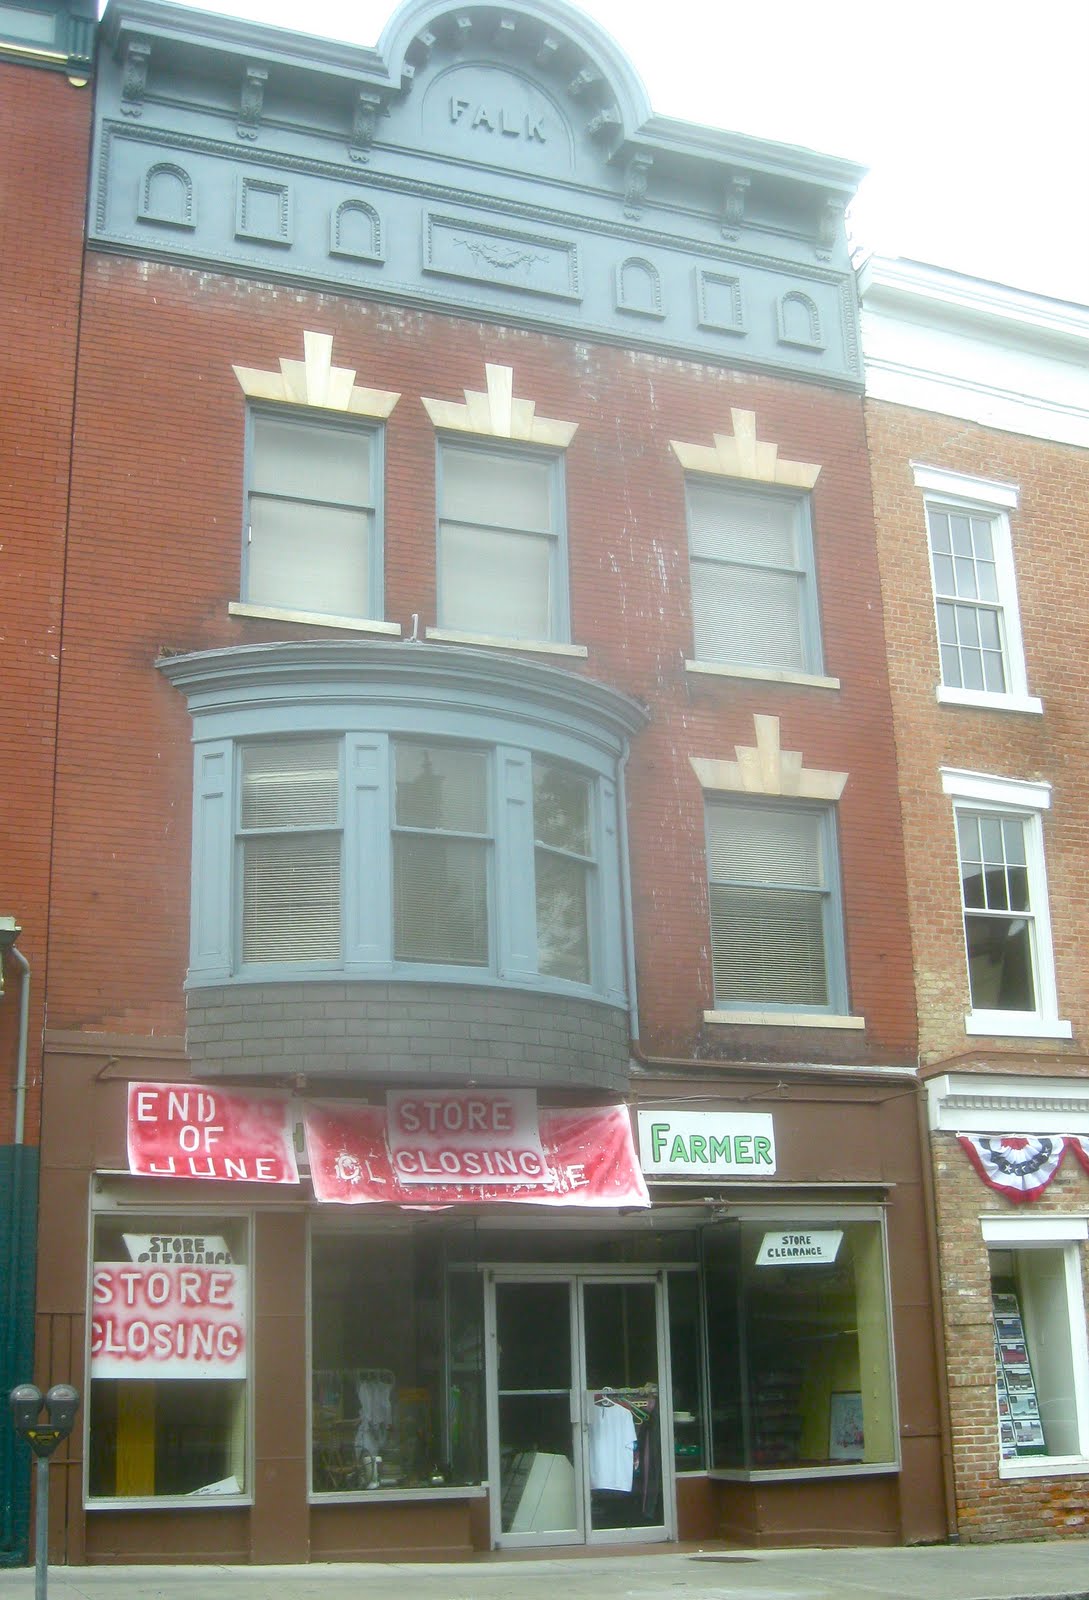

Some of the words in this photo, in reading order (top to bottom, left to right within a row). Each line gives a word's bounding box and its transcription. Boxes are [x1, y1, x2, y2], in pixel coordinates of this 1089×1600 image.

[448, 95, 547, 144] FALK
[136, 1092, 216, 1122] END
[400, 1102, 512, 1133] STORE
[179, 1125, 224, 1153] OF
[651, 1123, 773, 1164] FARMER
[150, 1156, 277, 1180] JUNE
[396, 1151, 540, 1174] CLOSING
[149, 1237, 205, 1253] STORE
[767, 1247, 822, 1258] CLEARANCE
[782, 1235, 812, 1245] STORE
[94, 1272, 231, 1305] STORE
